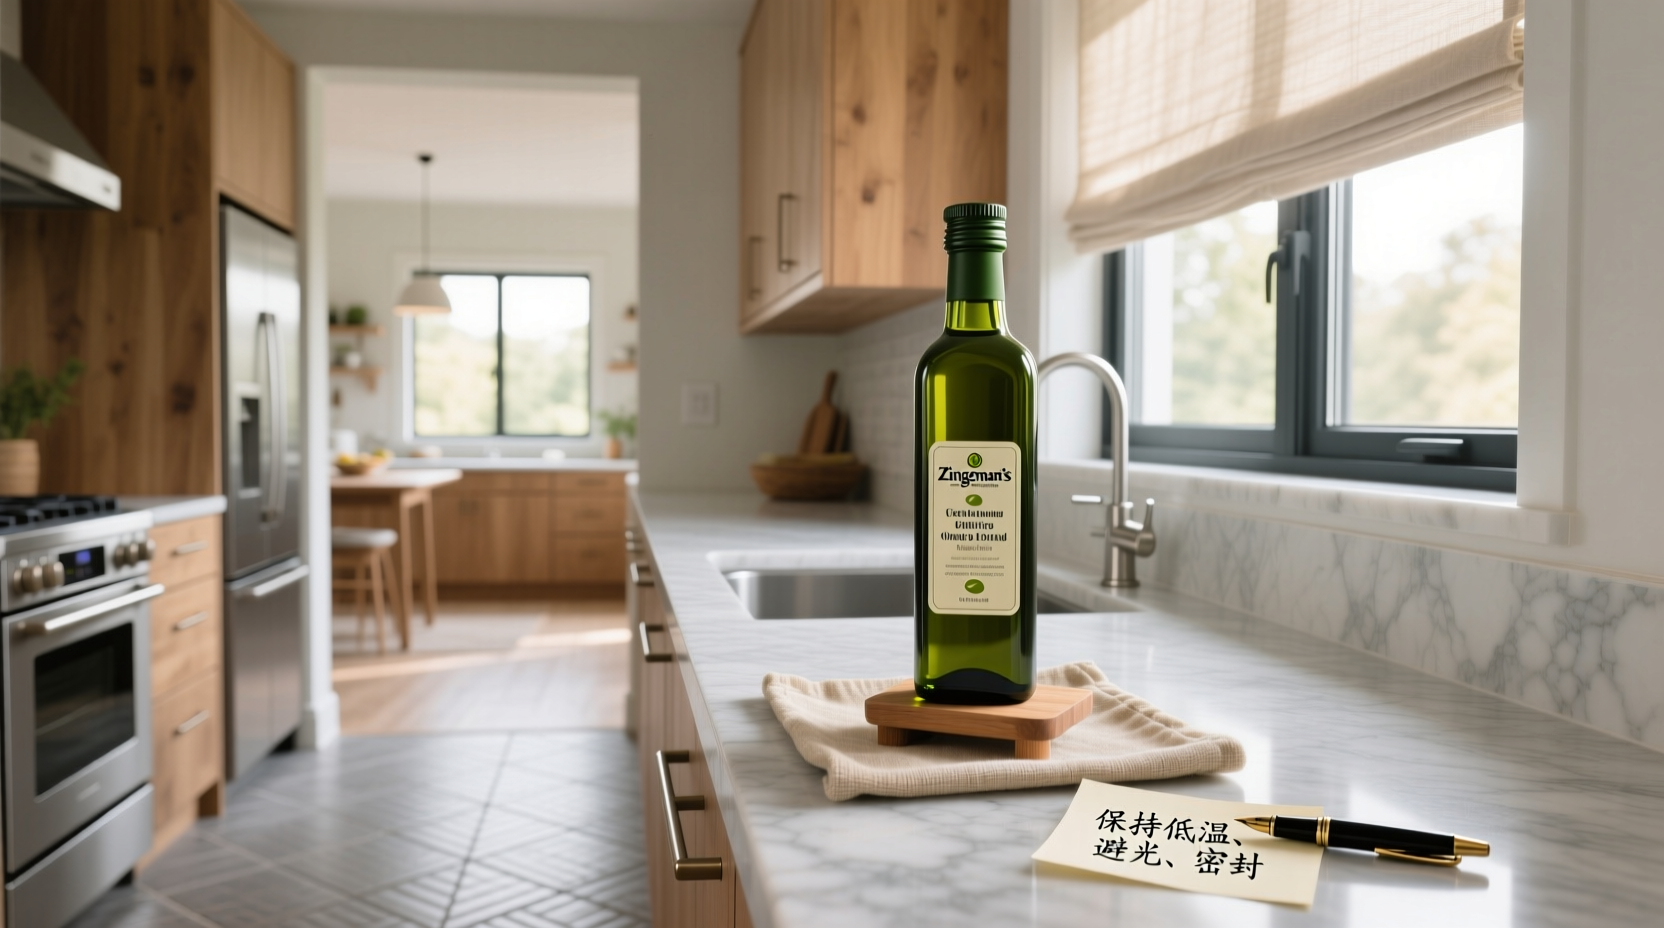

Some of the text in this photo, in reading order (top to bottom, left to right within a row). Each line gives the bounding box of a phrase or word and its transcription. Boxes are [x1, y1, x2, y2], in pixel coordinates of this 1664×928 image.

[1095, 808, 1243, 847] 保持低温、
[1093, 836, 1264, 880] 避光、密封
